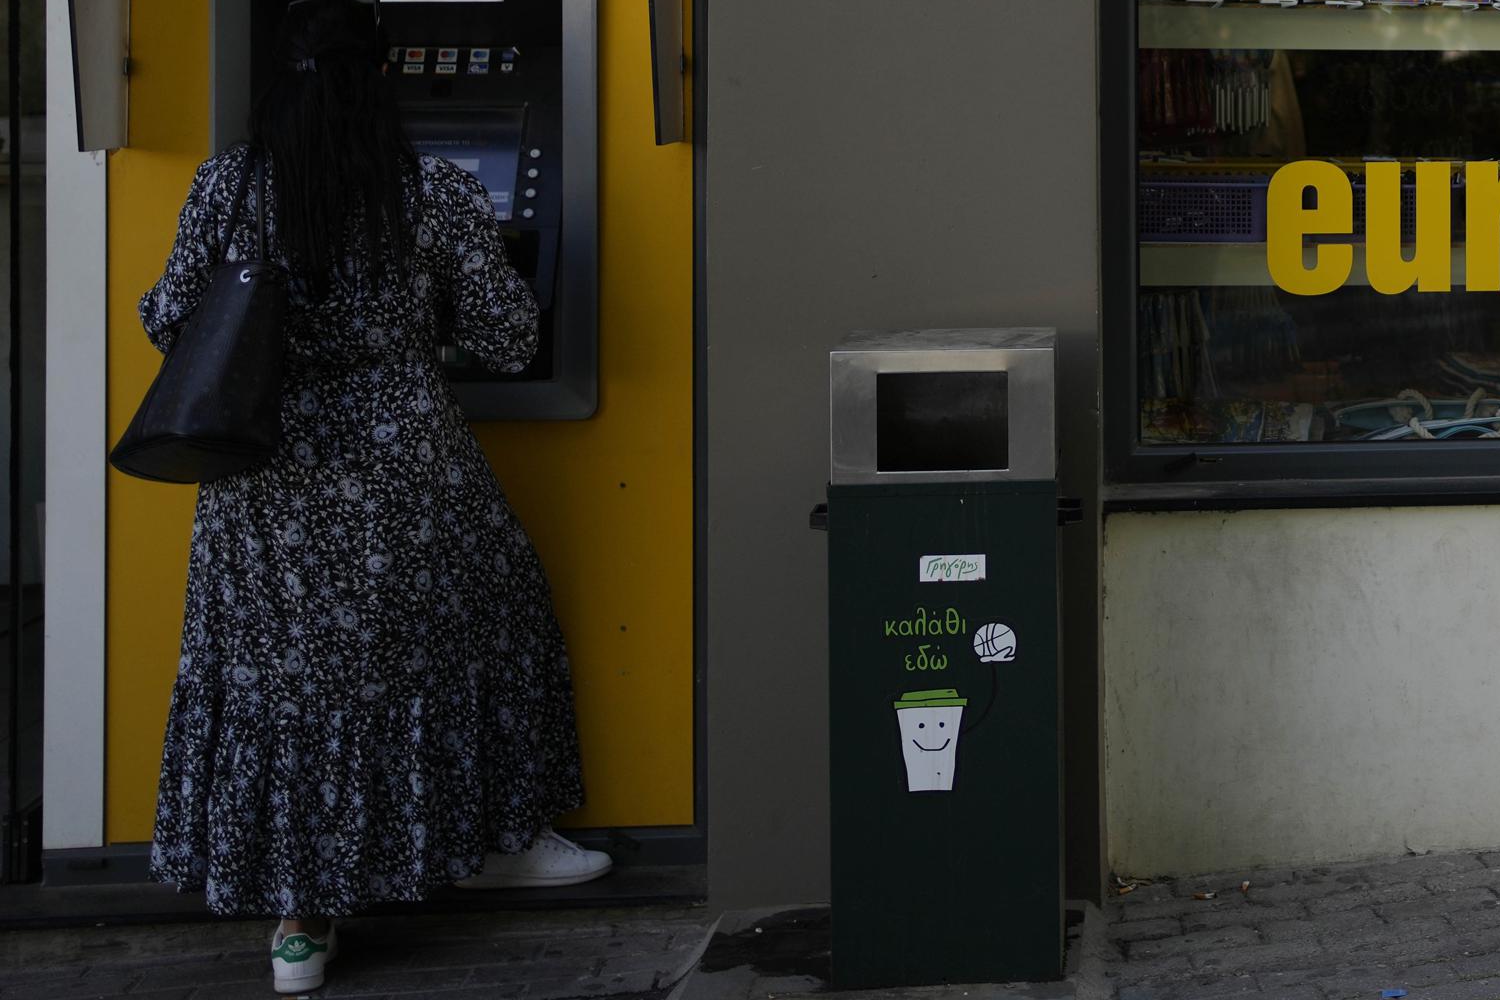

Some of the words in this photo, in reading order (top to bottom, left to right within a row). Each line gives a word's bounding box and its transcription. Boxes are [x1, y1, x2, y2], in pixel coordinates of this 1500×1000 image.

[926, 557, 978, 580] Γρηγόρης
[884, 607, 967, 638] καλάθι
[904, 645, 949, 671] εδώ
